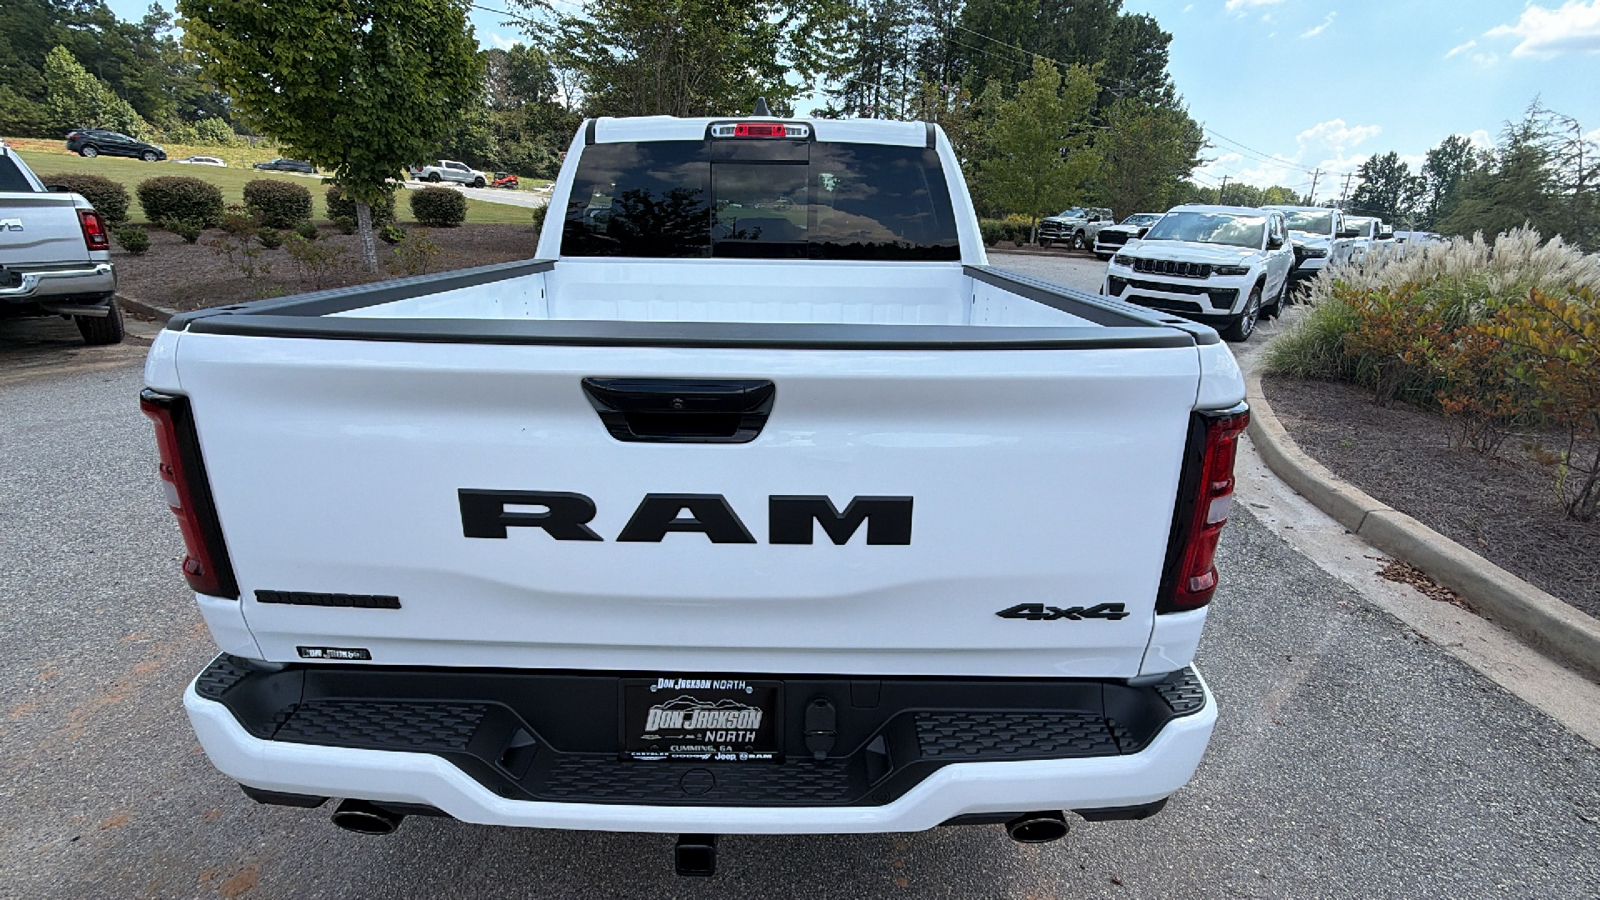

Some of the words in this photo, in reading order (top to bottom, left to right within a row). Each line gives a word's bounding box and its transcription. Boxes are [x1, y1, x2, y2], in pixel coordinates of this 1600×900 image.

[458, 488, 914, 545] RAM
[656, 678, 675, 690] DON
[675, 678, 711, 690] JACKSON
[713, 680, 746, 690] NORTH
[645, 709, 685, 732] DON
[683, 709, 763, 730] JACKSON
[705, 731, 756, 743] NORTH
